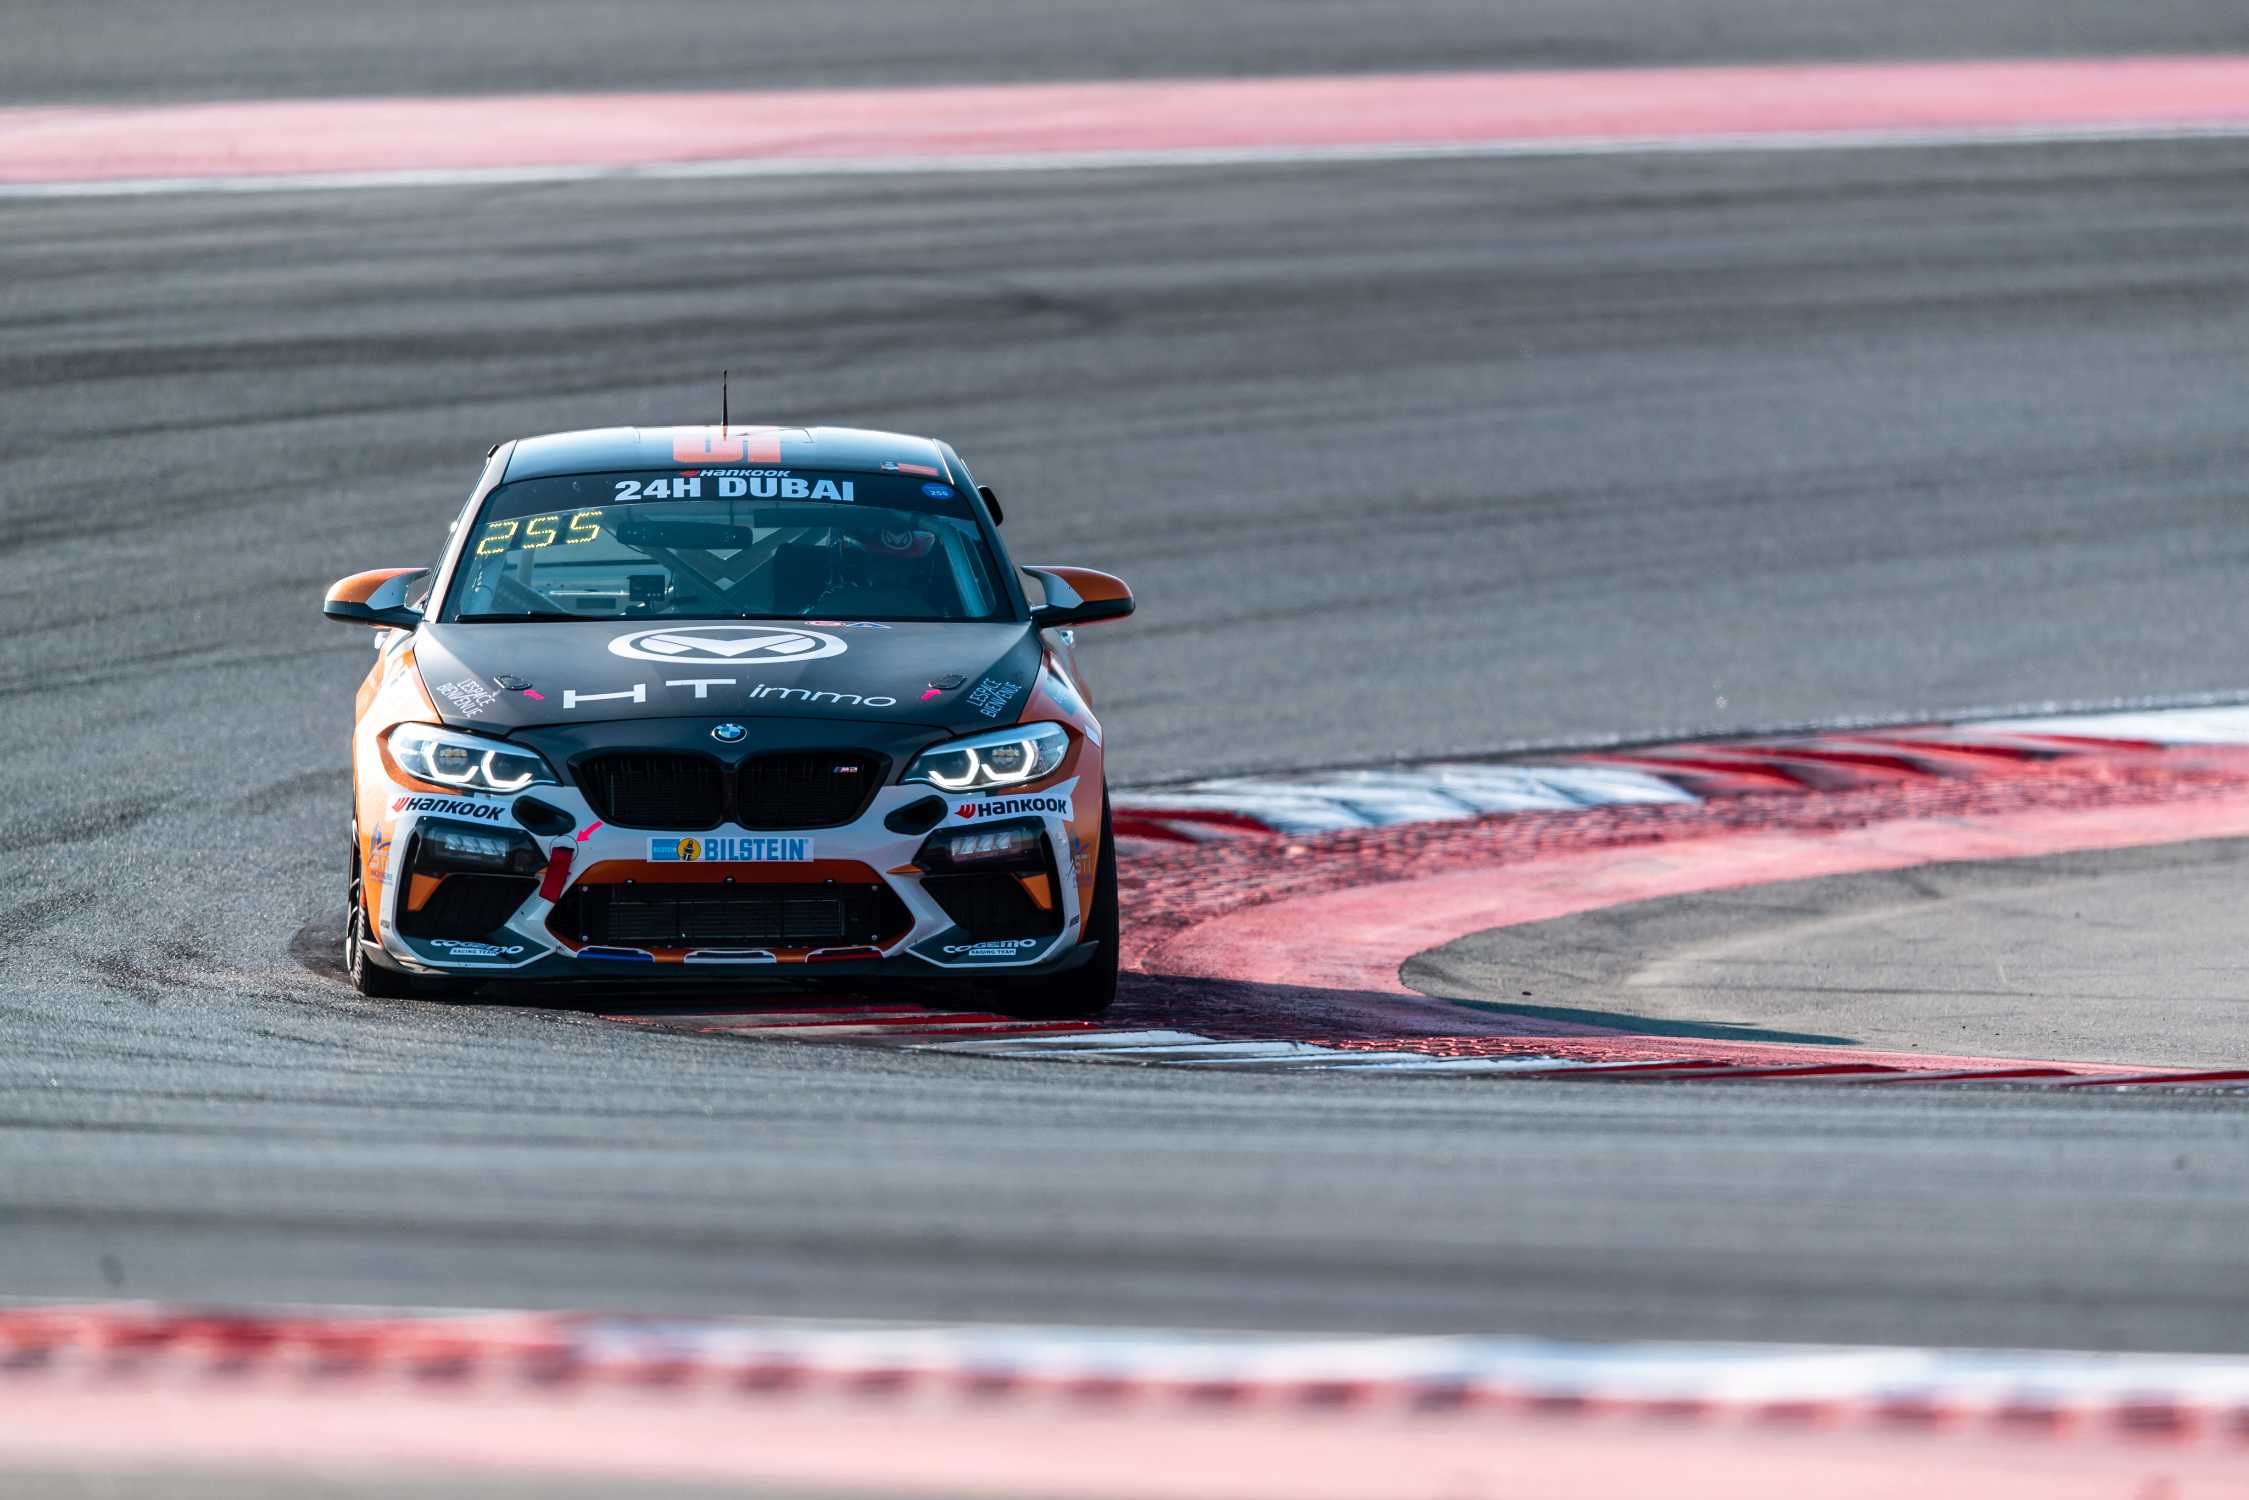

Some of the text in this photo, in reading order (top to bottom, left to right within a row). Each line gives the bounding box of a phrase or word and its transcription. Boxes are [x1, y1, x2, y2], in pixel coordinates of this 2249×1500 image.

[614, 476, 855, 501] 24H DUBAI
[476, 510, 604, 556] 255
[749, 683, 897, 707] immo
[704, 838, 805, 861] BILSTEIN
